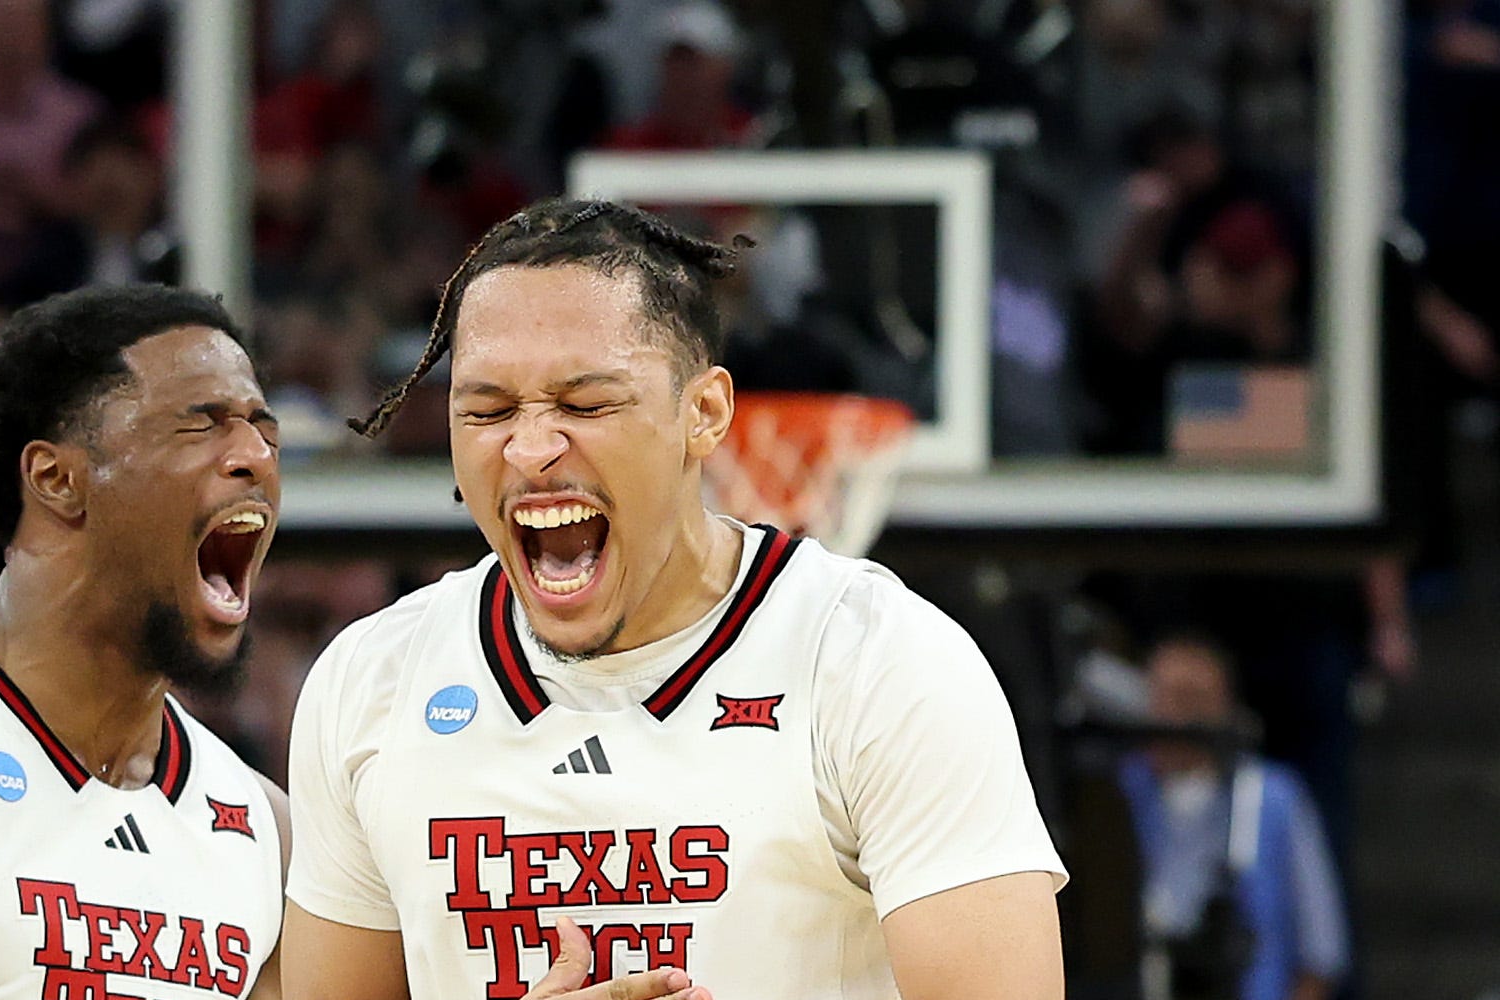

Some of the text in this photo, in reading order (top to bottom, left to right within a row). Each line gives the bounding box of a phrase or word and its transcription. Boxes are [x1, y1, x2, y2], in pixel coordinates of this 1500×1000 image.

[428, 706, 472, 721] NCAA
[429, 816, 729, 911] TEXAS
[16, 877, 250, 998] TEXAS
